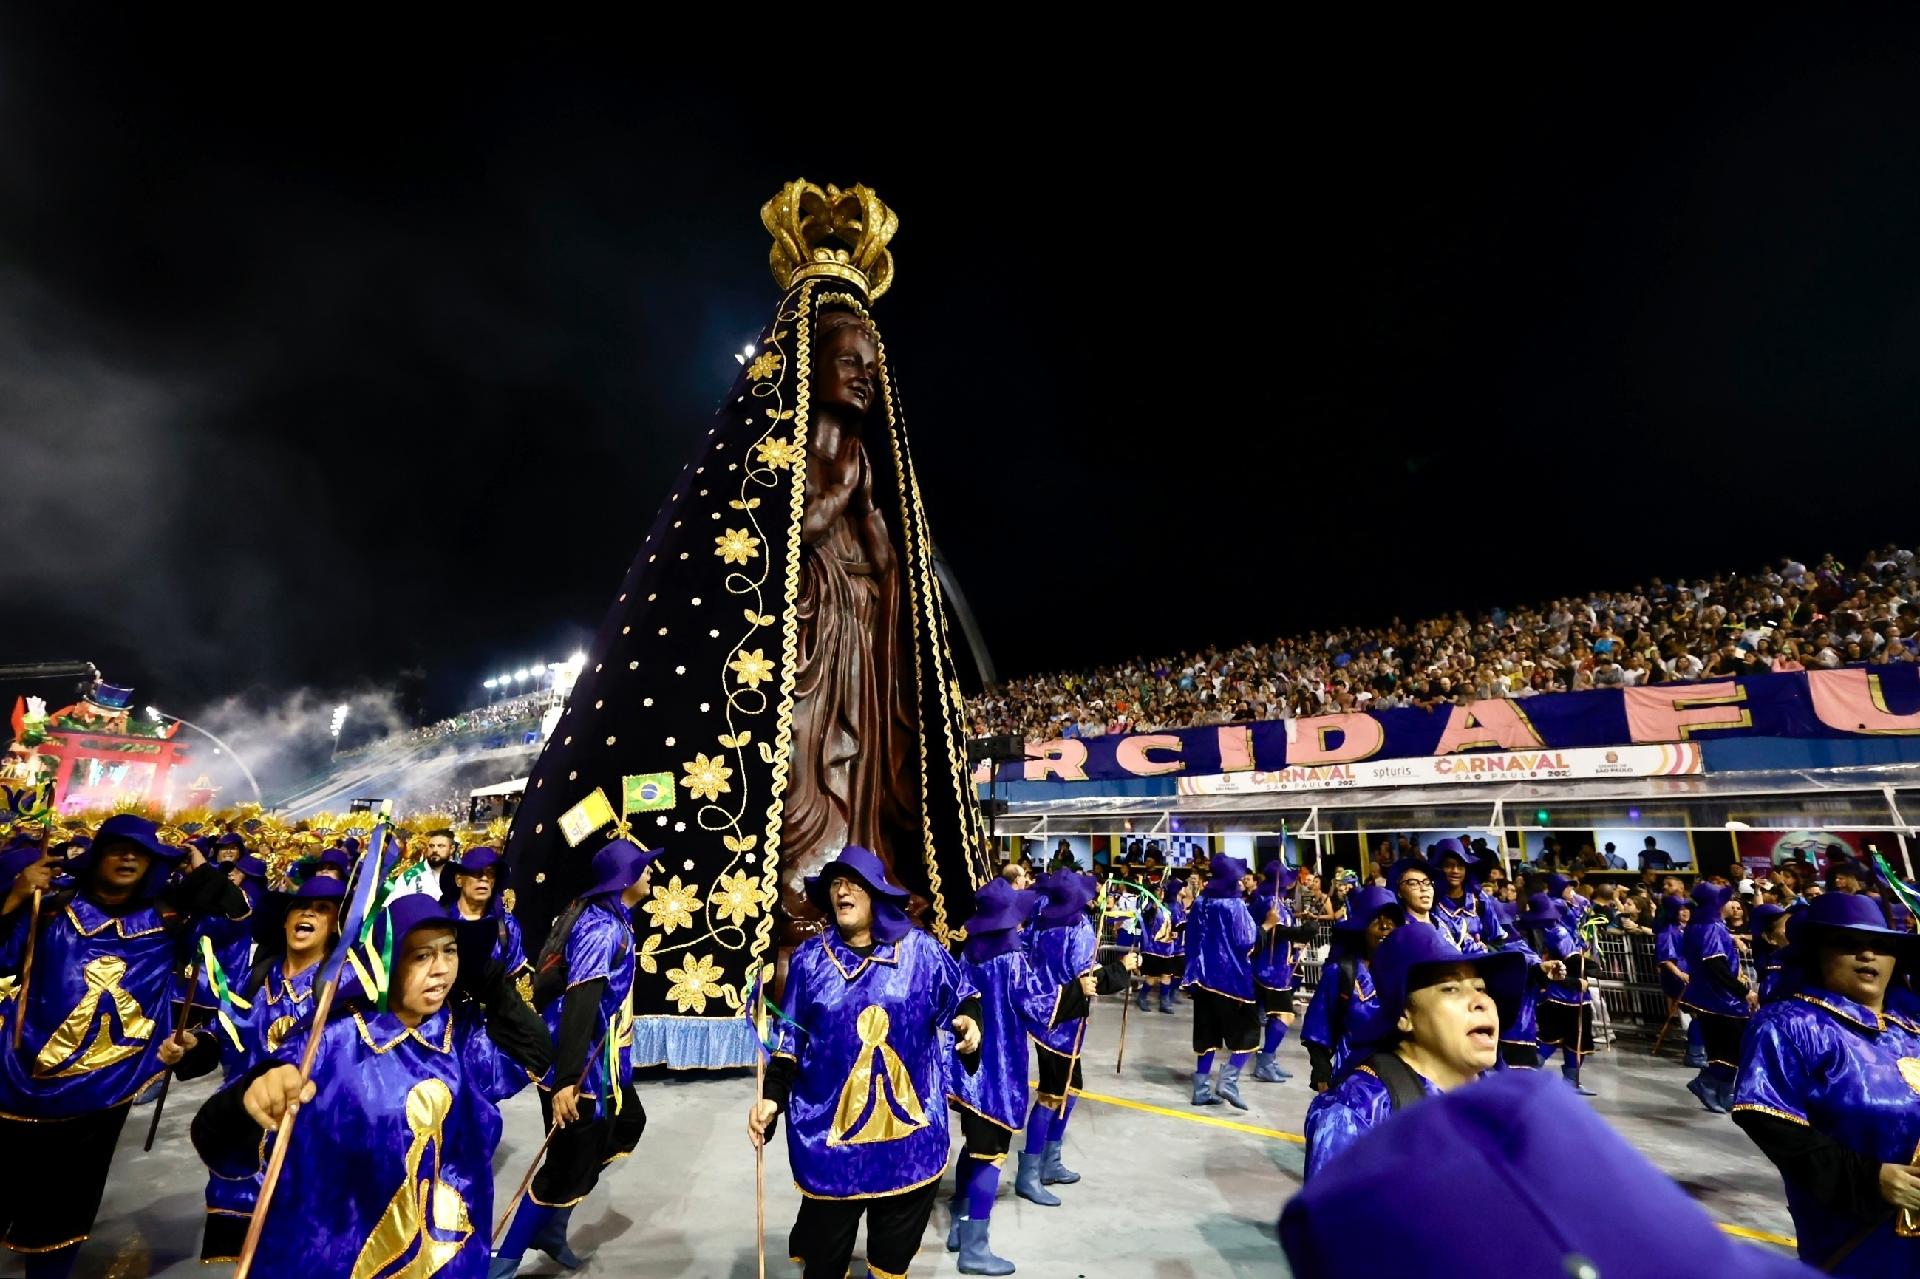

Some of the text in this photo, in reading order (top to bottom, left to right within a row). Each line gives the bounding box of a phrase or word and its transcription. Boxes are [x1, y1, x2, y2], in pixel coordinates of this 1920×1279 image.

[973, 698, 1546, 783] RCIDA
[1250, 764, 1356, 785] CARNAVAL
[1372, 767, 1412, 778] spturis
[1434, 753, 1570, 775] CARNAVAL
